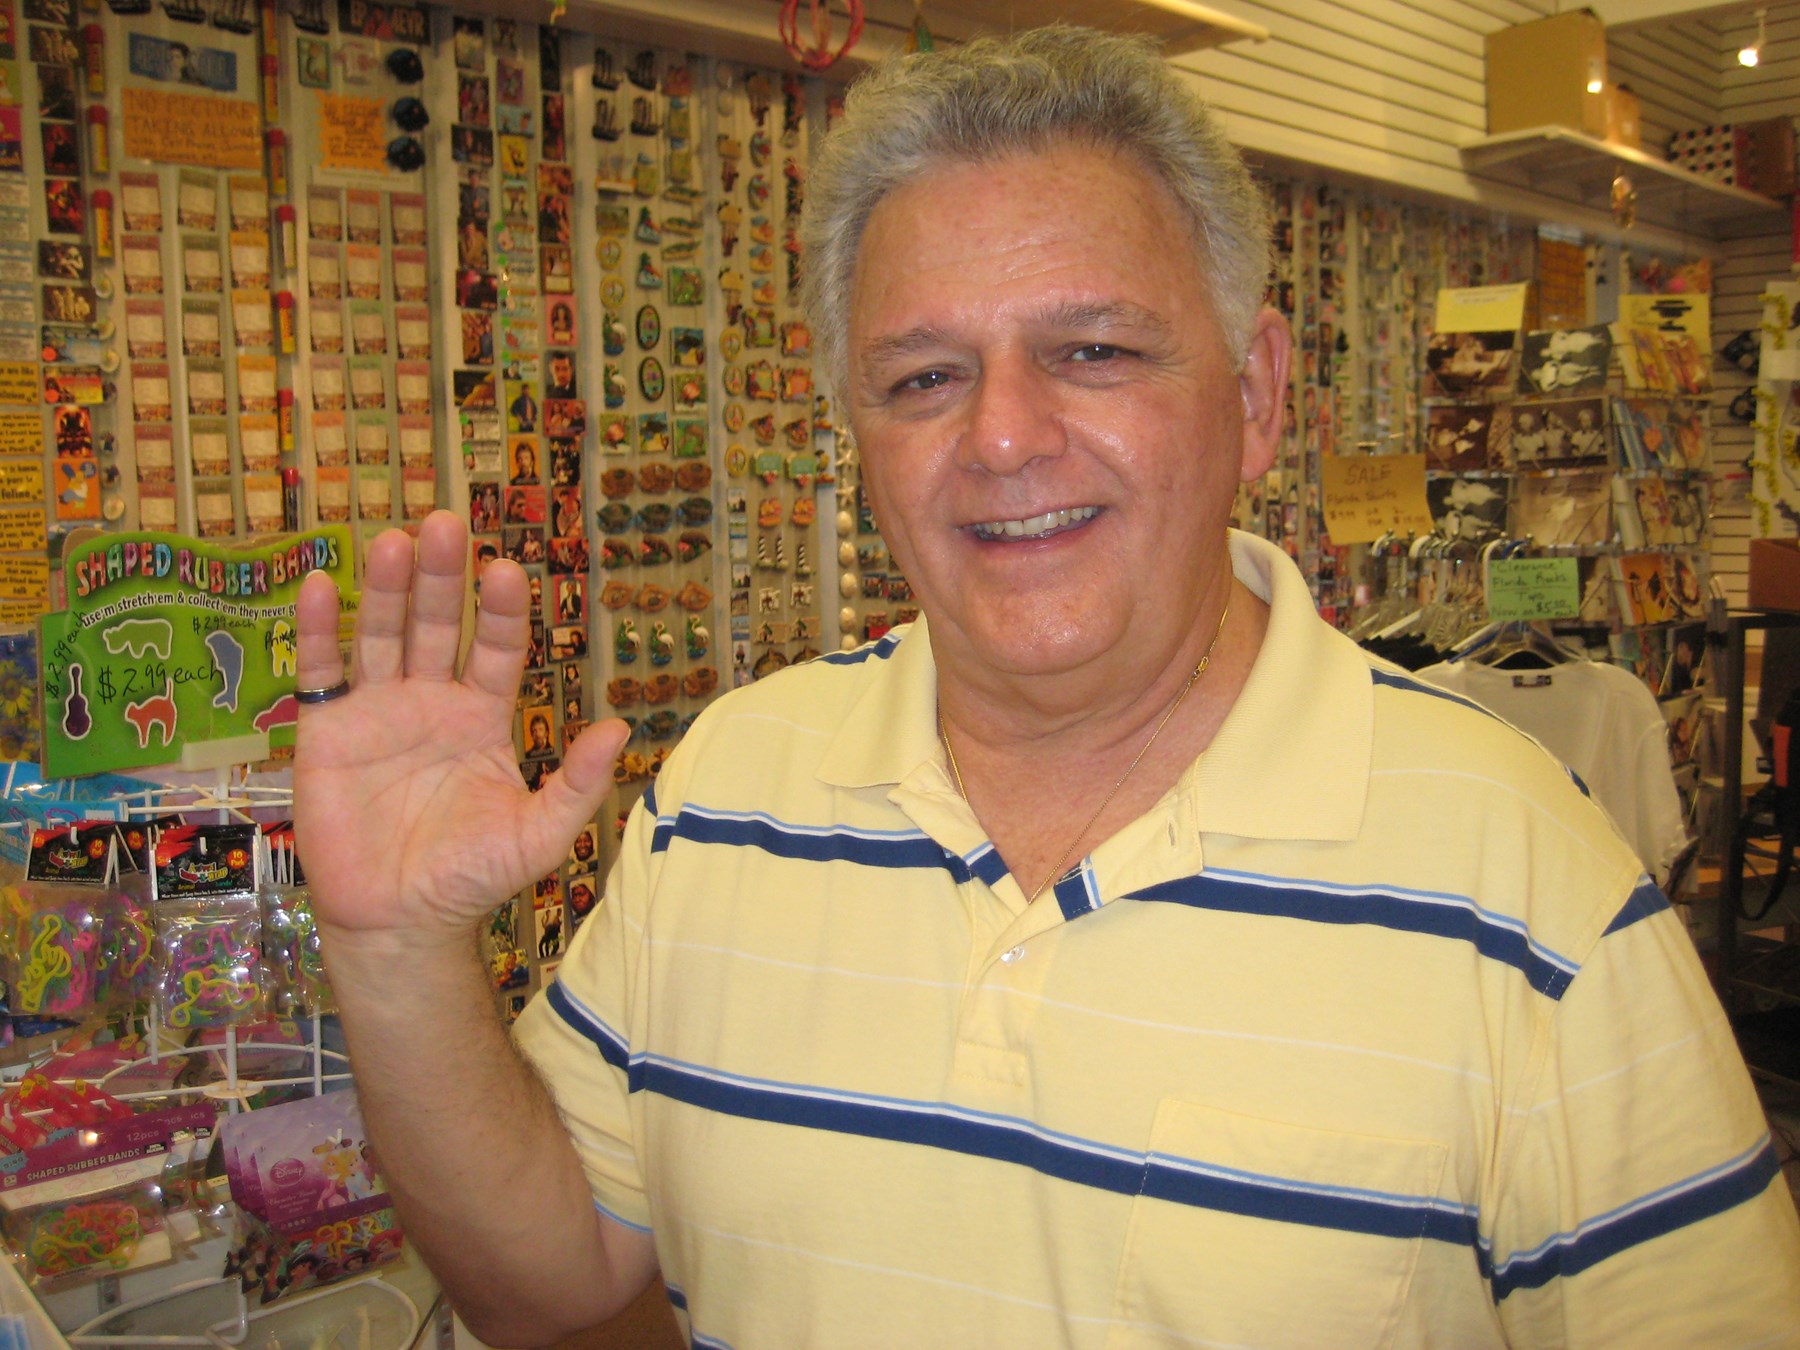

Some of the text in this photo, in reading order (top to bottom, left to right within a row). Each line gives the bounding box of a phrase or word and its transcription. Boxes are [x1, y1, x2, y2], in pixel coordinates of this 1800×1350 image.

[129, 90, 254, 120] NO PICTURE
[126, 115, 194, 136] TAKING
[1344, 463, 1391, 485] SALE
[75, 536, 339, 597] SHAPED RUBBER BANDS
[82, 604, 116, 628] use'm
[118, 591, 174, 611] stretch'em
[177, 590, 186, 604] &
[188, 592, 237, 616] collect'em
[239, 605, 259, 621] they
[261, 606, 286, 619] never
[264, 628, 297, 651] Prince
[174, 660, 226, 686] each
[94, 839, 103, 848] 10
[233, 850, 243, 859] 10
[230, 858, 245, 867] Pack
[126, 1129, 160, 1142] 12pcs
[26, 1147, 141, 1182] SHAPED RUBBER BANDS
